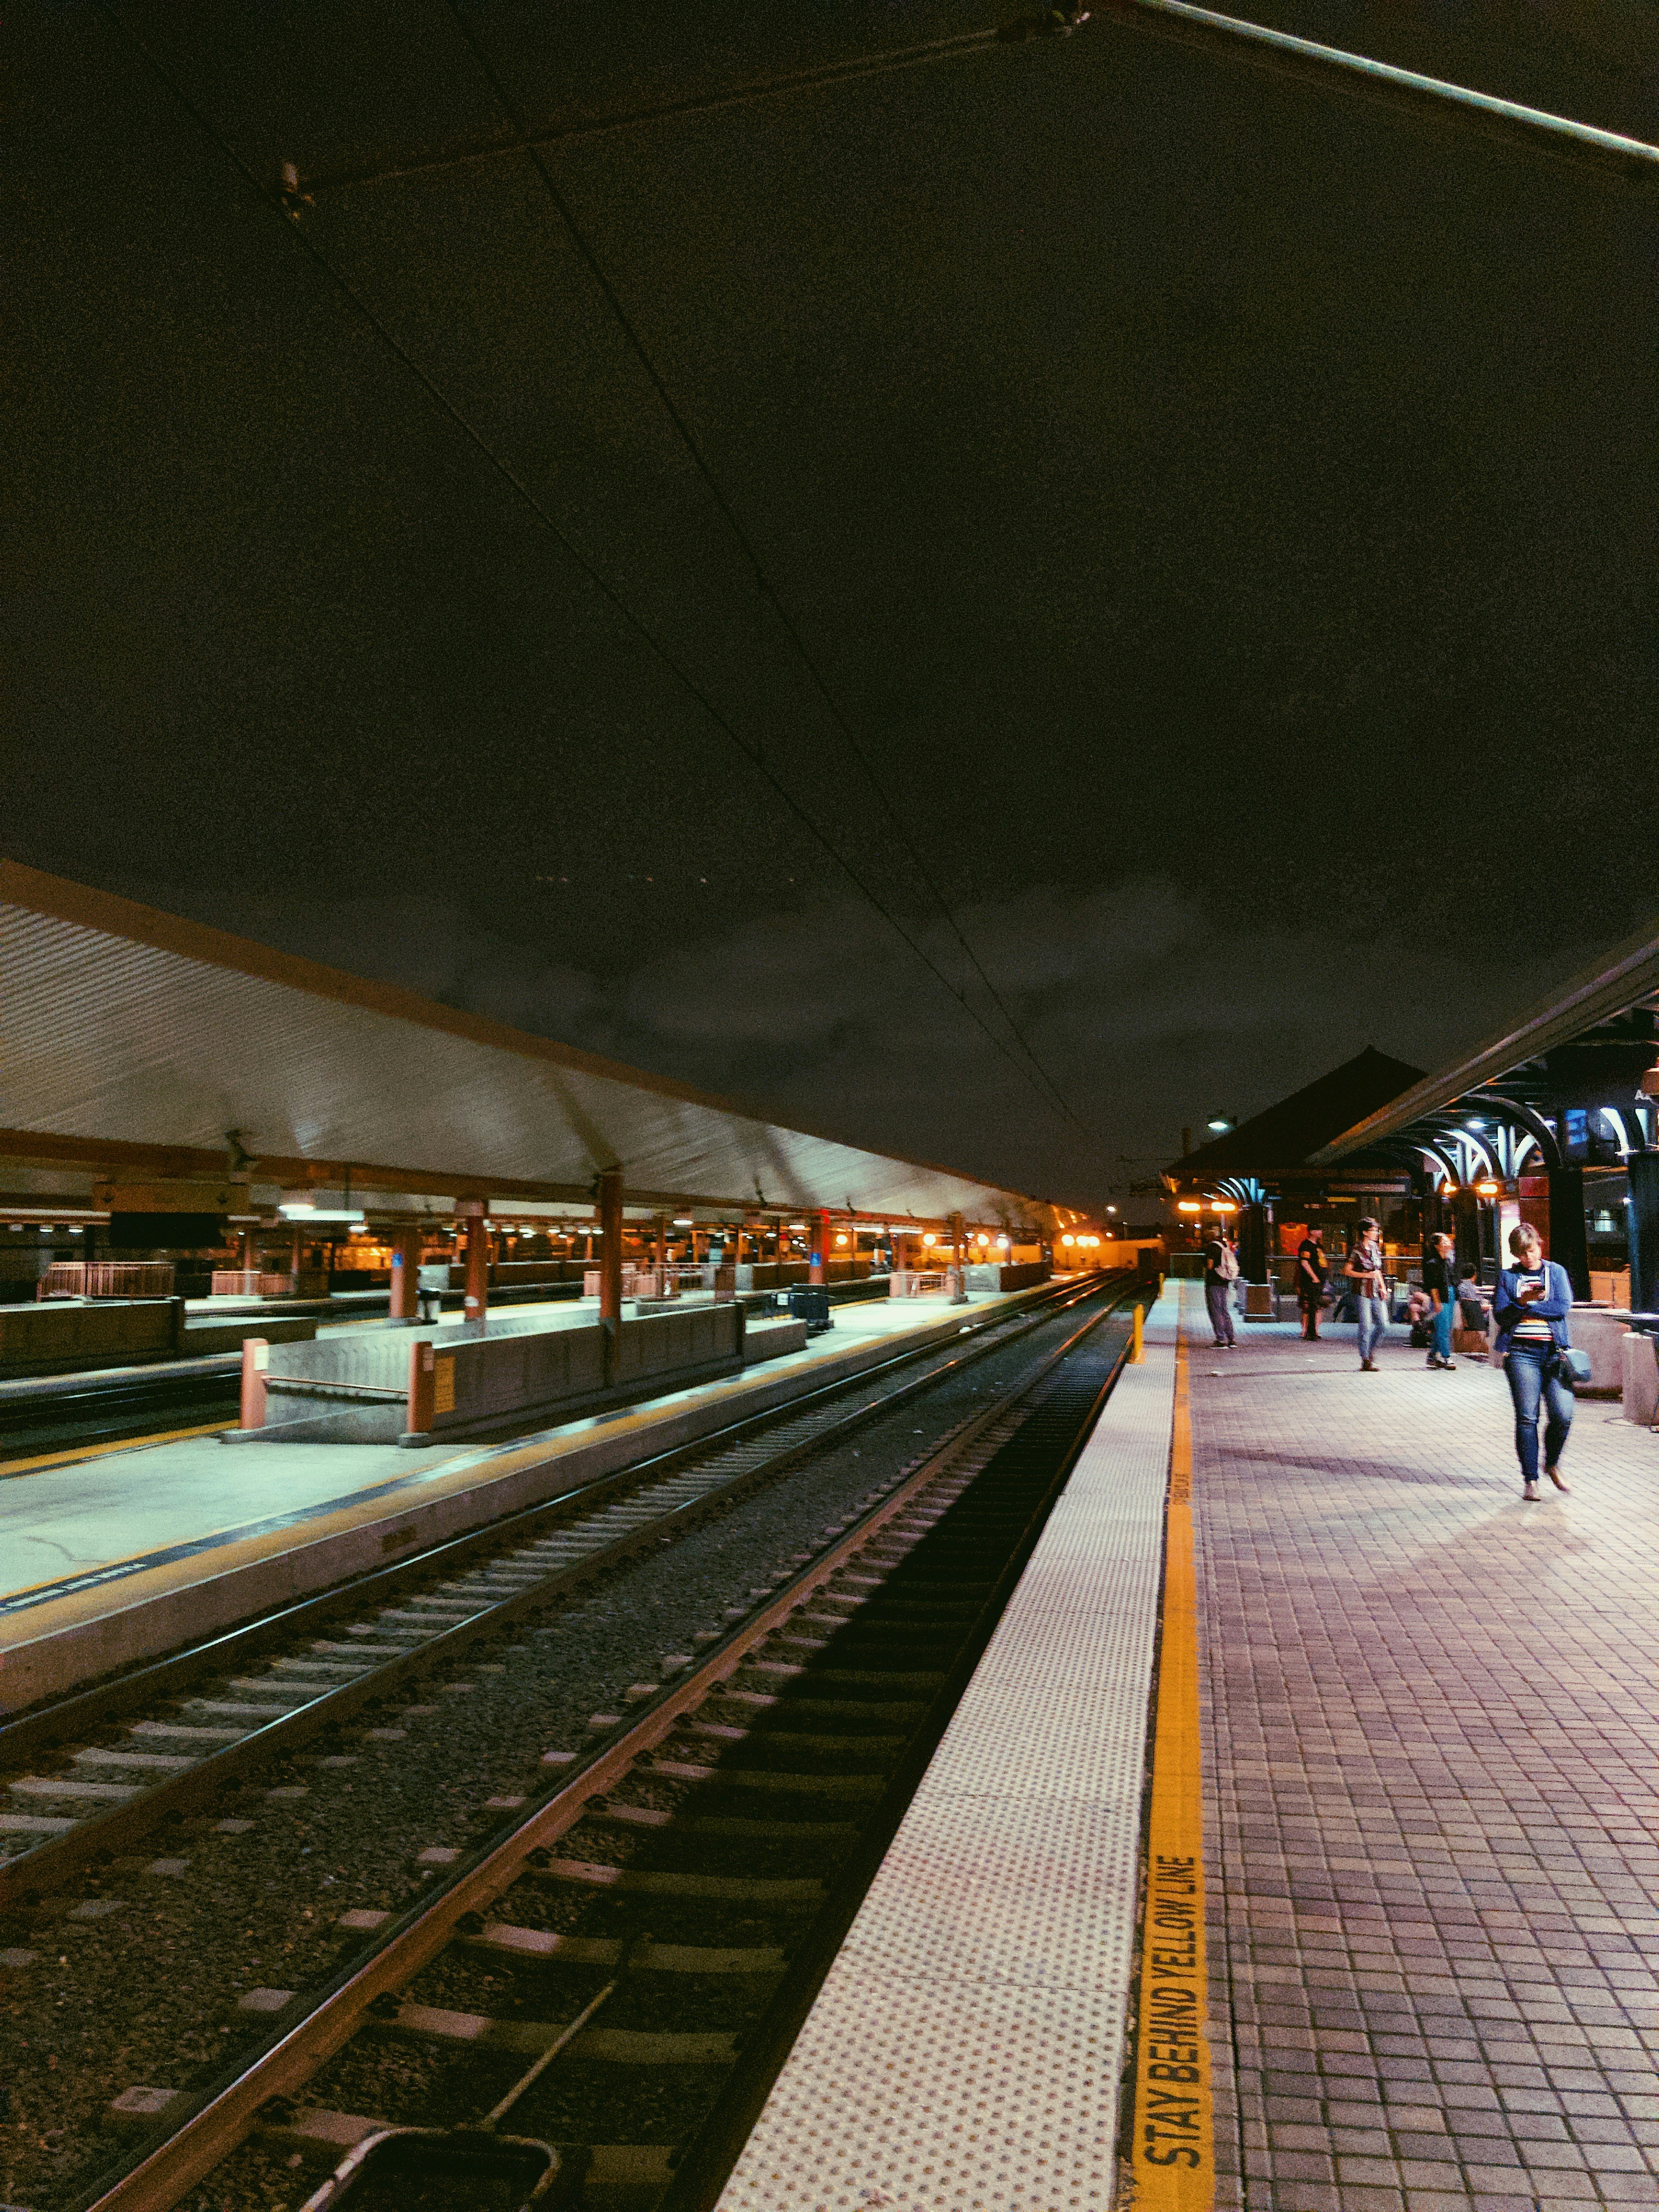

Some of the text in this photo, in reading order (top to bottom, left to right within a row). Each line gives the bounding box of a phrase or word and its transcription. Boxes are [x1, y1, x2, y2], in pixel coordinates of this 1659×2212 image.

[1144, 1855, 1200, 2168] STAY BEHIND YELLOW LINE
